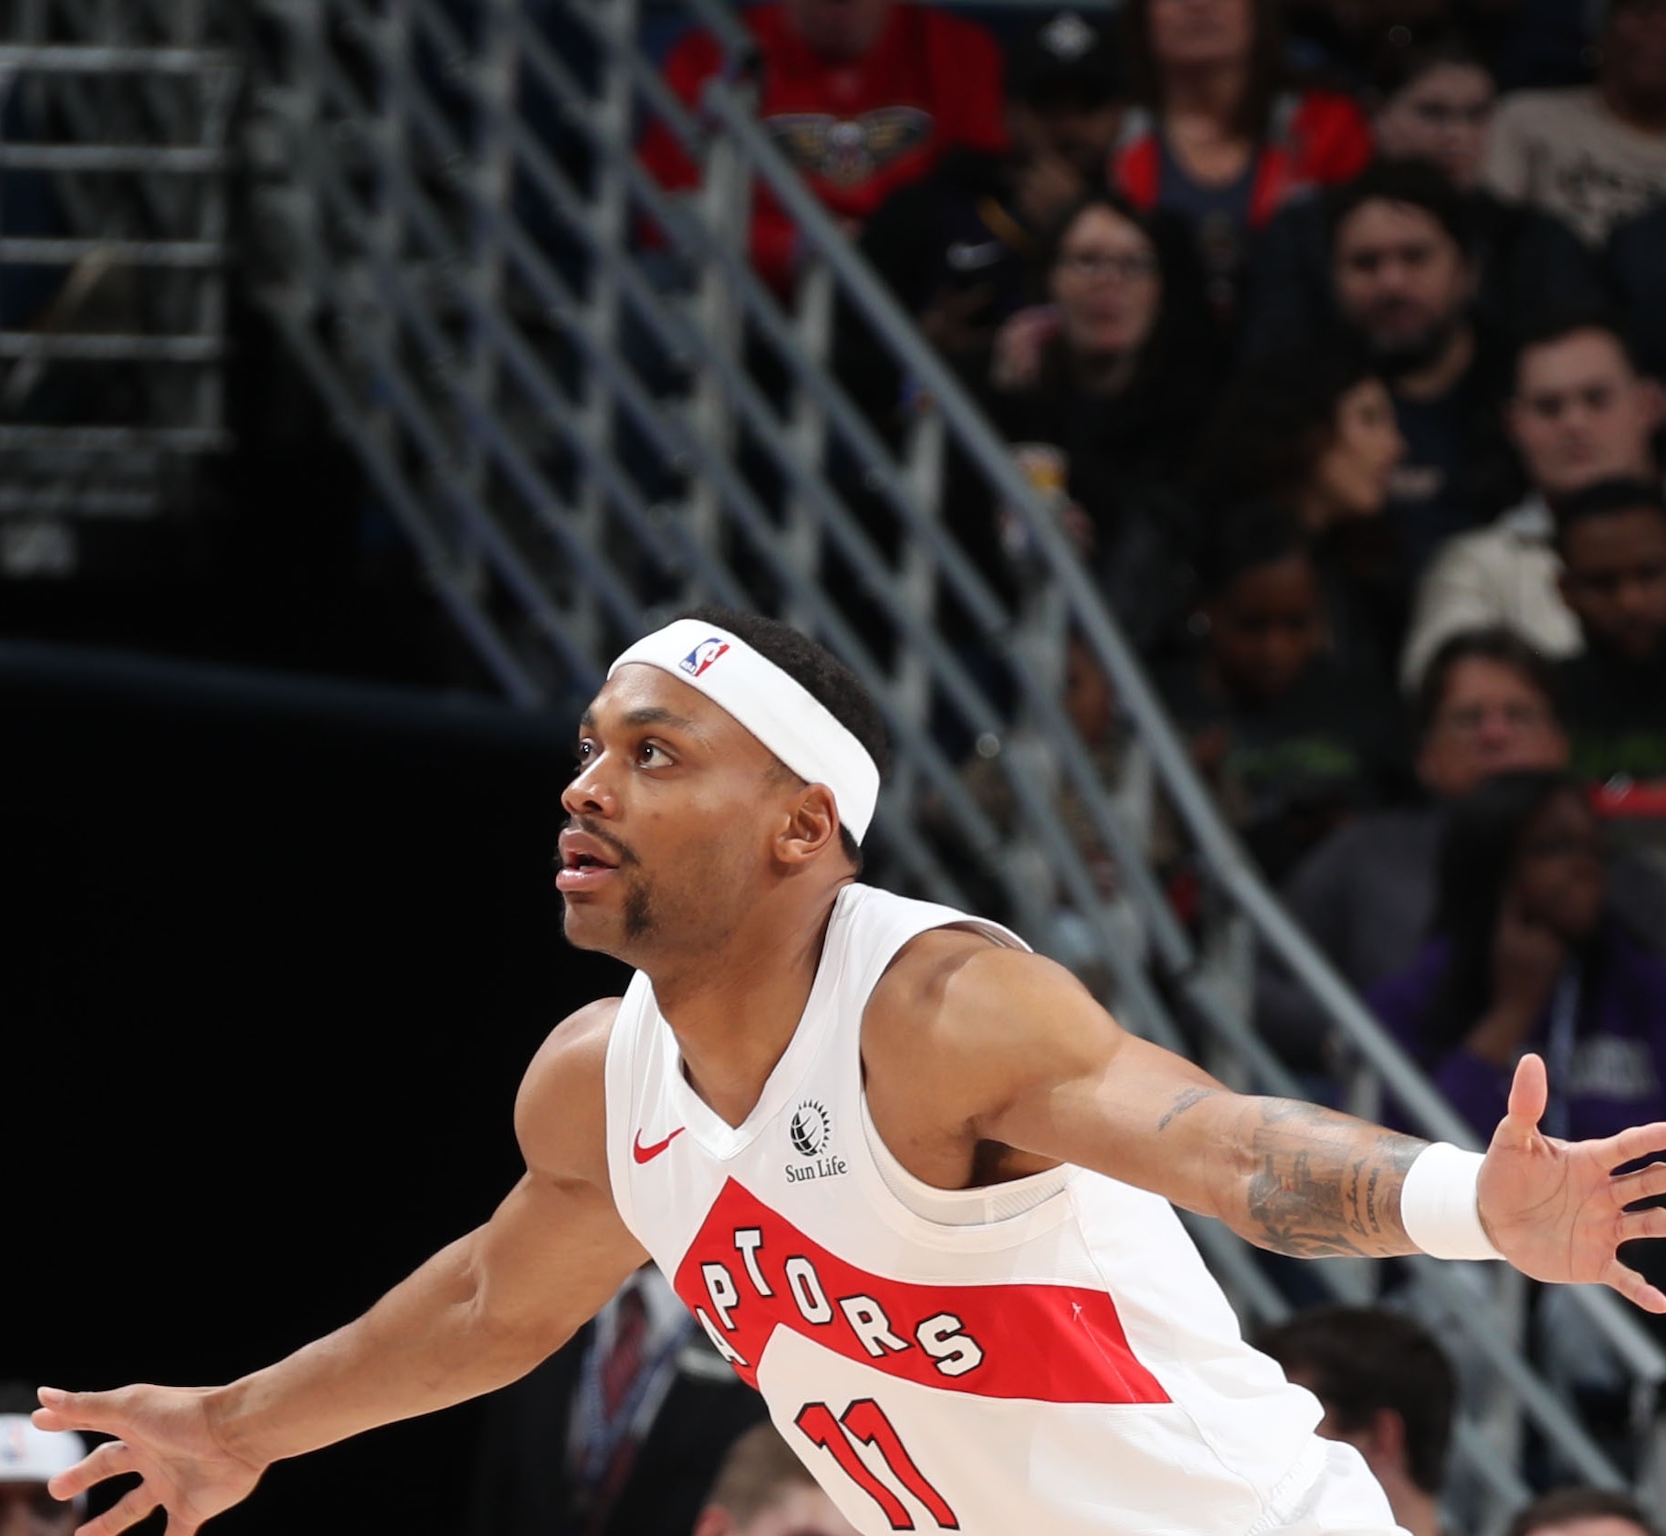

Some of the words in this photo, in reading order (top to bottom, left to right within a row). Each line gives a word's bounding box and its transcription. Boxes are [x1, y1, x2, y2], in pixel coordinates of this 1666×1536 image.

[784, 1164, 816, 1183] Sun
[816, 1155, 849, 1178] Life
[694, 1226, 986, 1378] APTORS
[794, 1398, 961, 1531] 11
